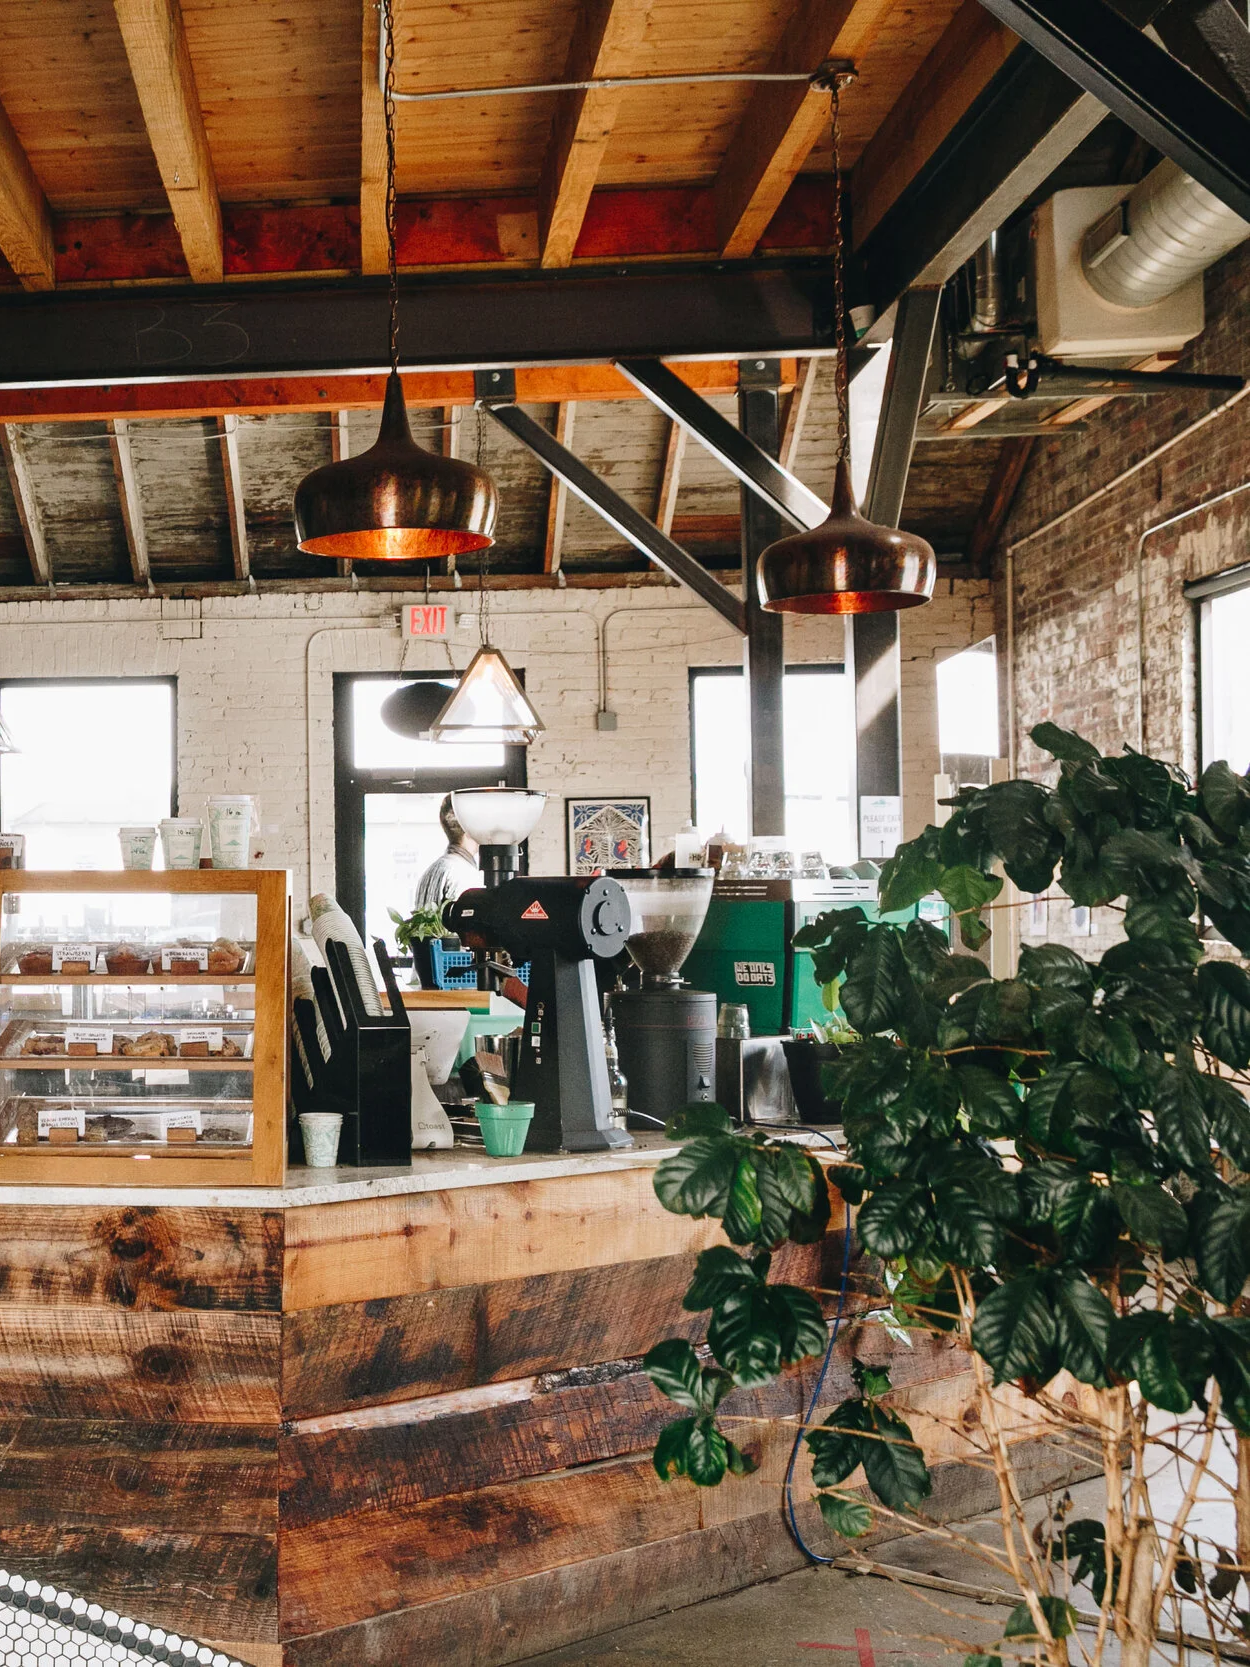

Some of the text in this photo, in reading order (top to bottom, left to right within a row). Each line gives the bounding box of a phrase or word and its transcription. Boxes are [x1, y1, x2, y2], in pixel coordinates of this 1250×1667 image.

[410, 607, 448, 635] EXIT
[866, 825, 897, 834] THIS WAY
[425, 1122, 446, 1130] toast
